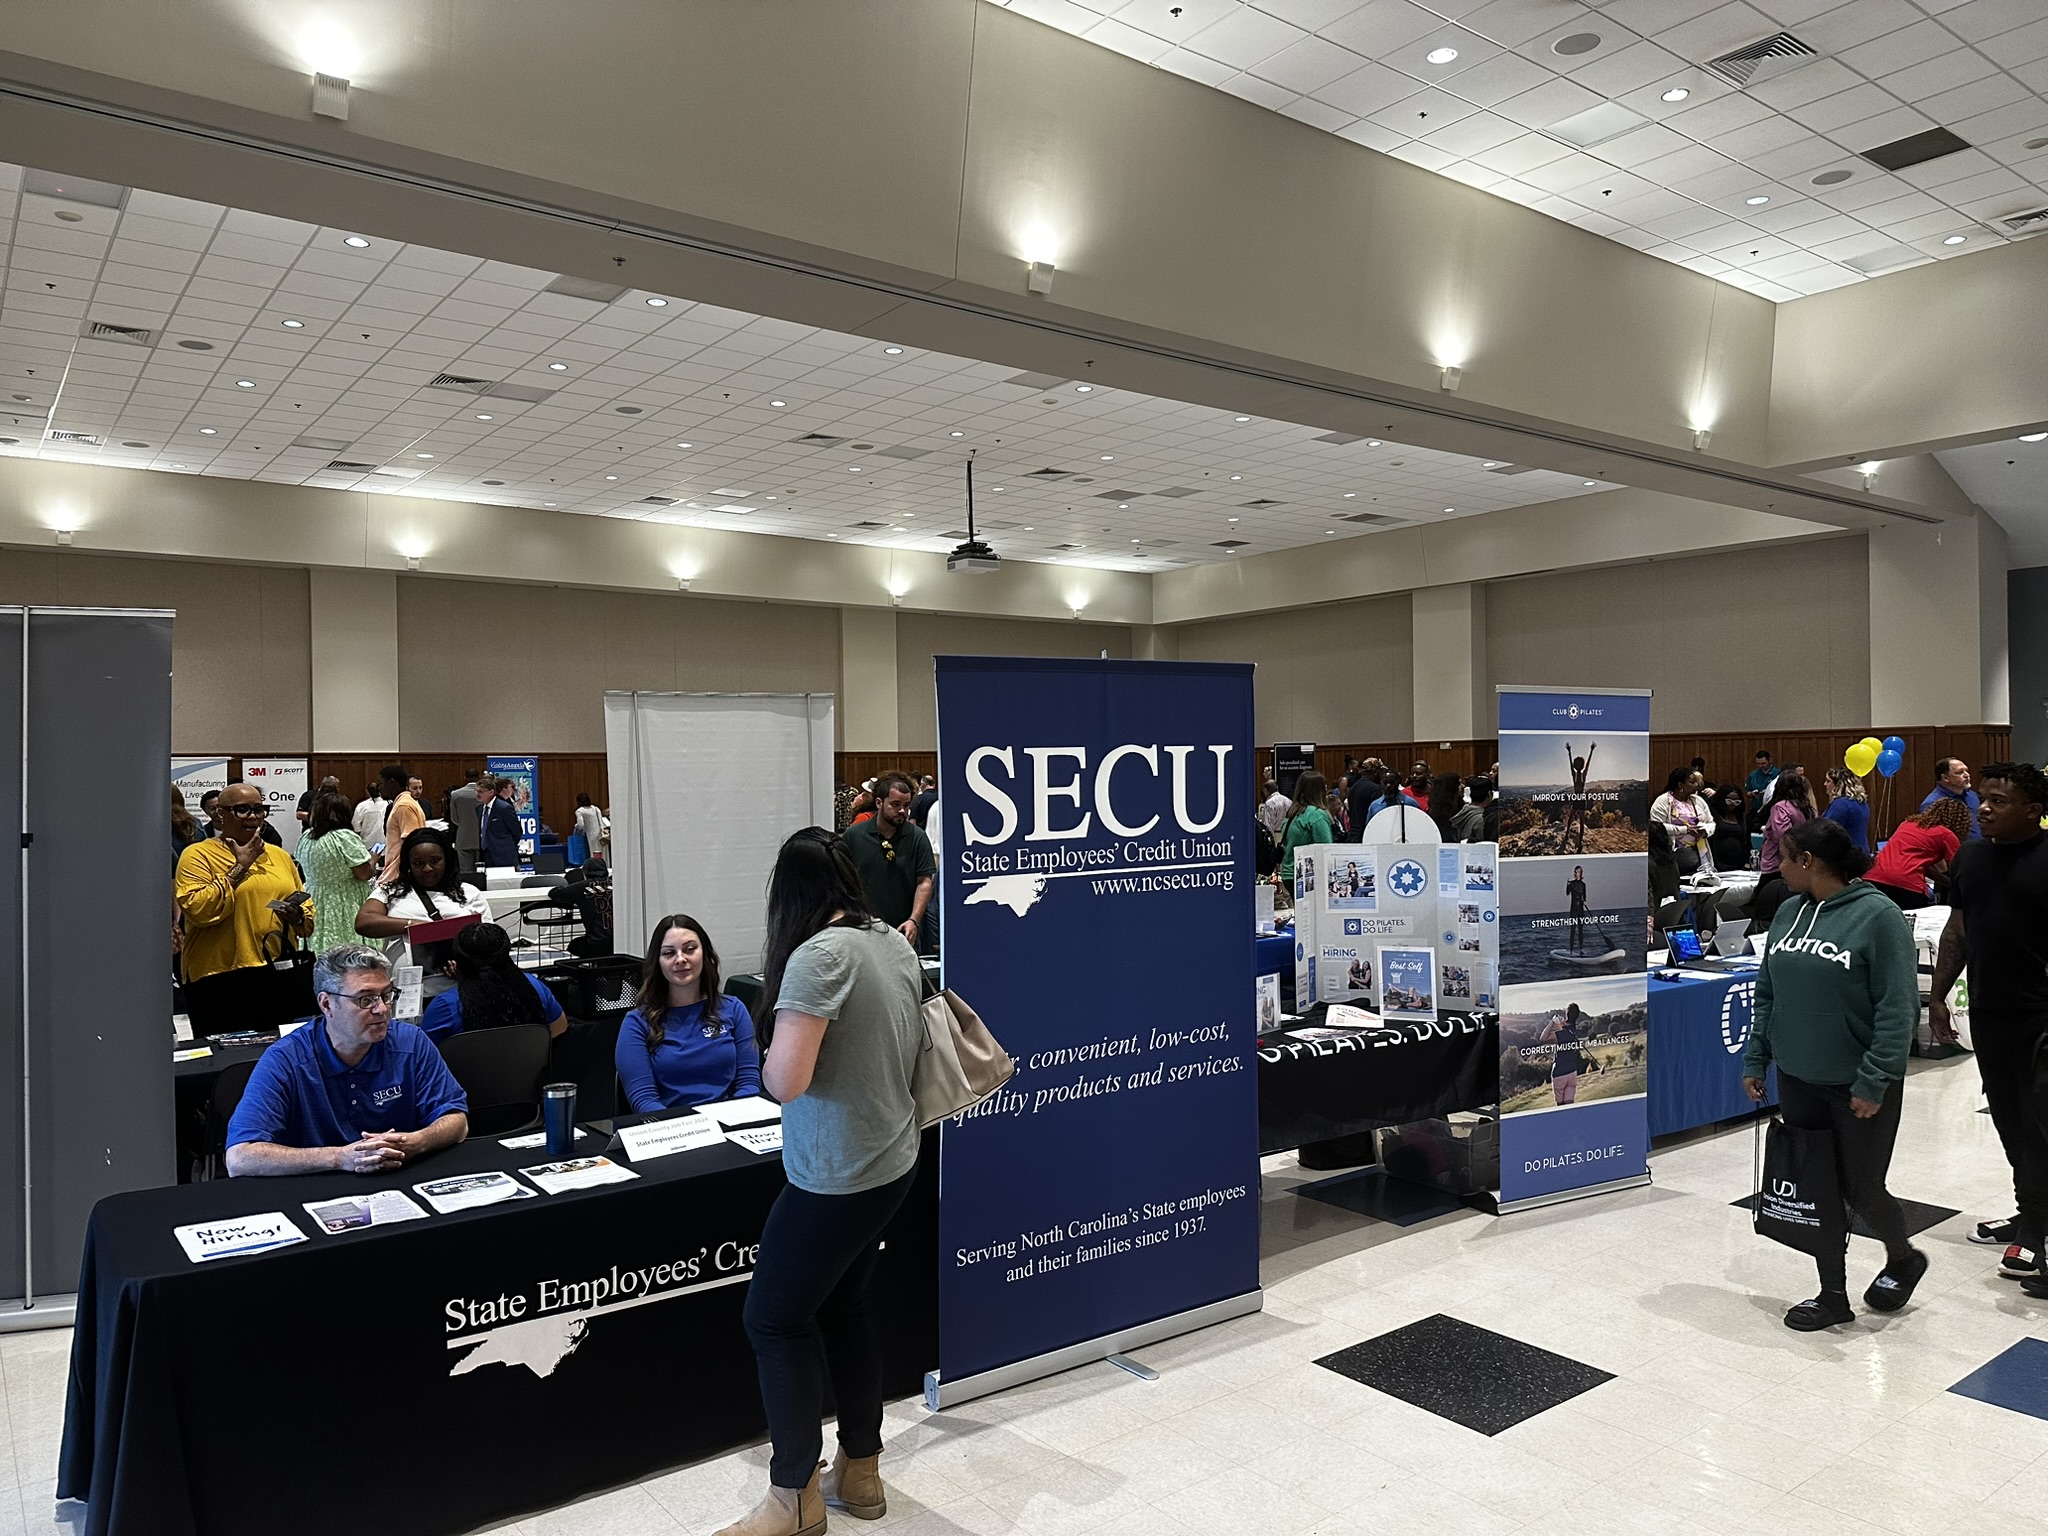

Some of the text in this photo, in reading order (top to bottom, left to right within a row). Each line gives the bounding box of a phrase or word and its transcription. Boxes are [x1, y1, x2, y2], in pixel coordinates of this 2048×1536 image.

[248, 767, 266, 776] 3M
[175, 780, 226, 789] Manufacturing
[962, 744, 1233, 846] SECU
[1532, 792, 1619, 802] IMPROVE YOUR POSTURE
[961, 836, 1232, 874] State Employees' Credit Union
[1091, 869, 1234, 896] www.ncsecu.org
[1362, 926, 1376, 934] DO
[1531, 914, 1620, 929] STRENGTHEN YOUR CORE
[1323, 948, 1357, 957] HIRING
[1389, 960, 1424, 974] Best Self
[1029, 1034, 1142, 1071] convenient,
[1149, 1021, 1230, 1051] low-cost,
[1520, 1035, 1629, 1056] CORRECT MUSCLE IMBALANCES
[373, 1085, 402, 1101] SECU
[1033, 1071, 1122, 1114] products
[1127, 1061, 1163, 1090] and
[1168, 1053, 1245, 1083] services.
[629, 1129, 648, 1138] Union
[648, 1125, 670, 1134] County
[636, 1128, 711, 1148] State Employees Credit Union
[1524, 1159, 1541, 1173] DO
[1542, 1152, 1585, 1170] PILATES.
[1587, 1148, 1602, 1162] DO
[1772, 1178, 1797, 1200] UDI
[1770, 1202, 1802, 1216] Industries
[1778, 1197, 1816, 1210] Diversified
[196, 1225, 246, 1239] Now
[201, 1224, 282, 1245] Hiring!
[956, 1184, 1247, 1267] Serving North Carolina's State employees
[1006, 1215, 1207, 1282] and their families since 1937.
[445, 1241, 760, 1333] State Employees' Cre
